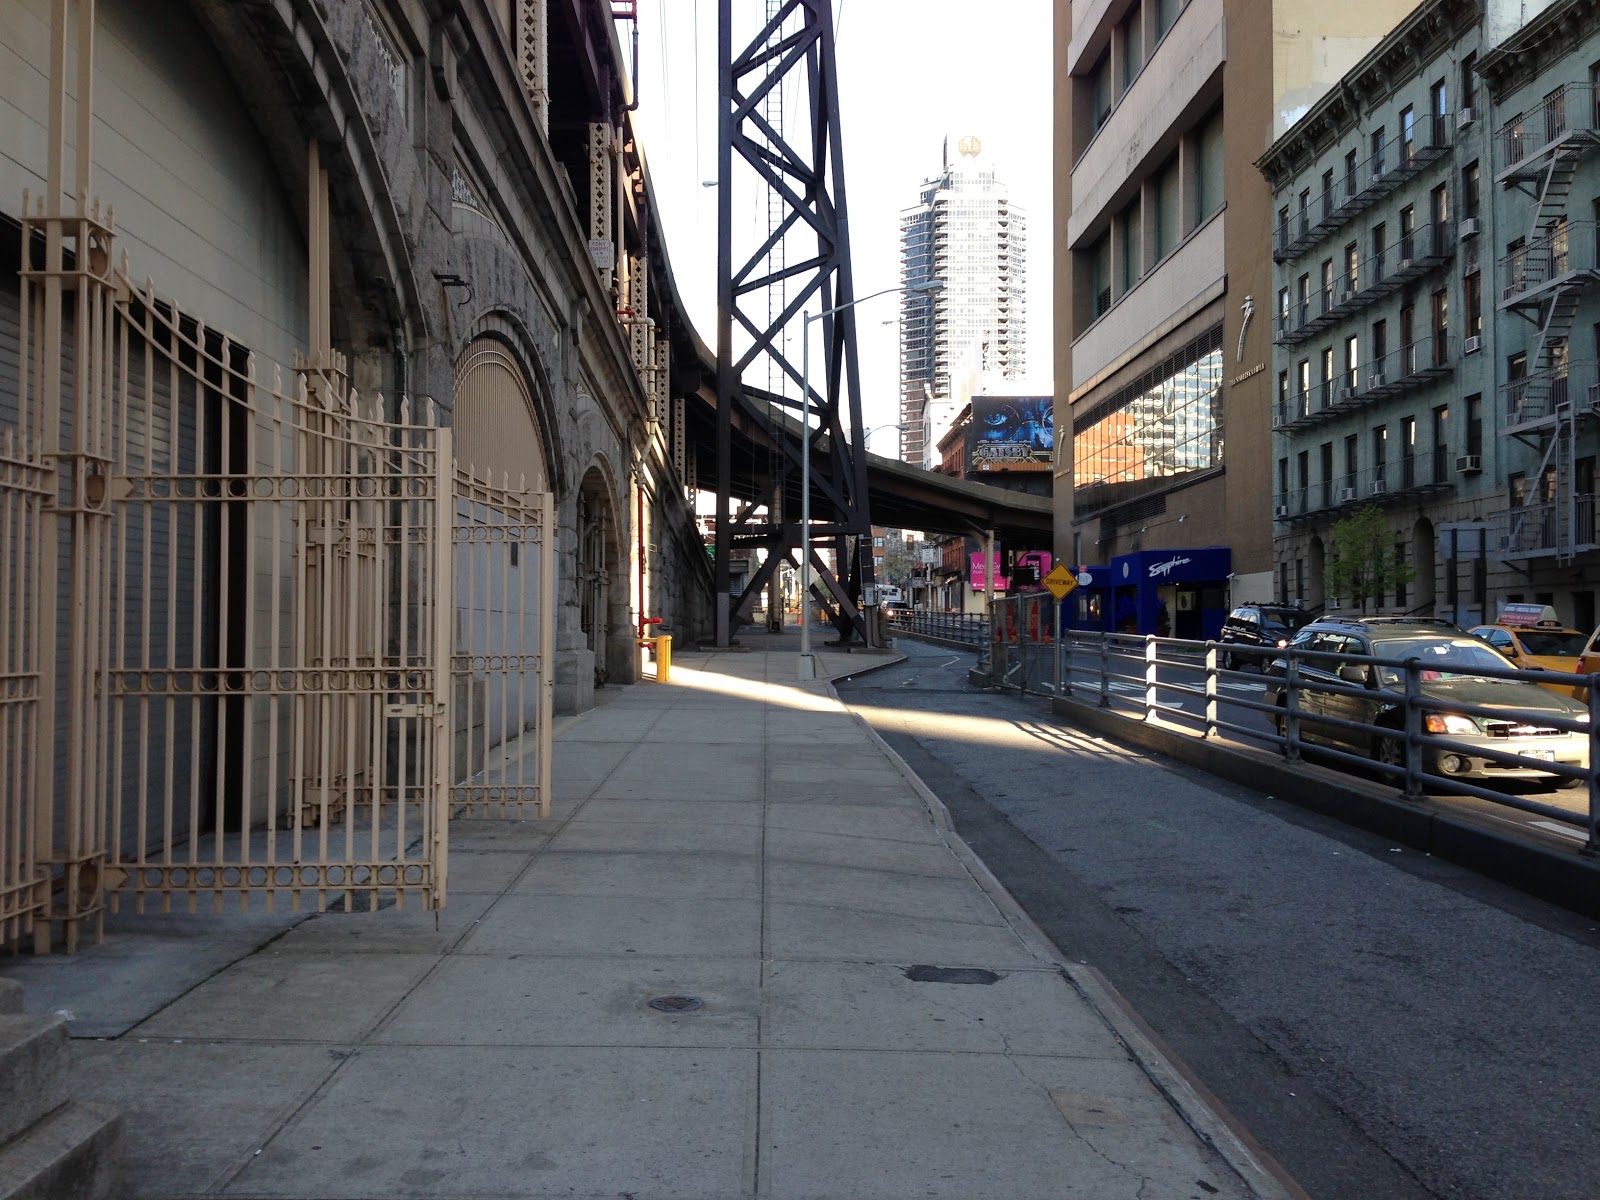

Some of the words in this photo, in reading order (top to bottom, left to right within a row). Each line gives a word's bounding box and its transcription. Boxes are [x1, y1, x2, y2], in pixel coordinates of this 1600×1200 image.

[979, 447, 1029, 458] GATSBY
[1149, 555, 1191, 577] Sapphire
[1045, 578, 1074, 587] DRIVEWAY
